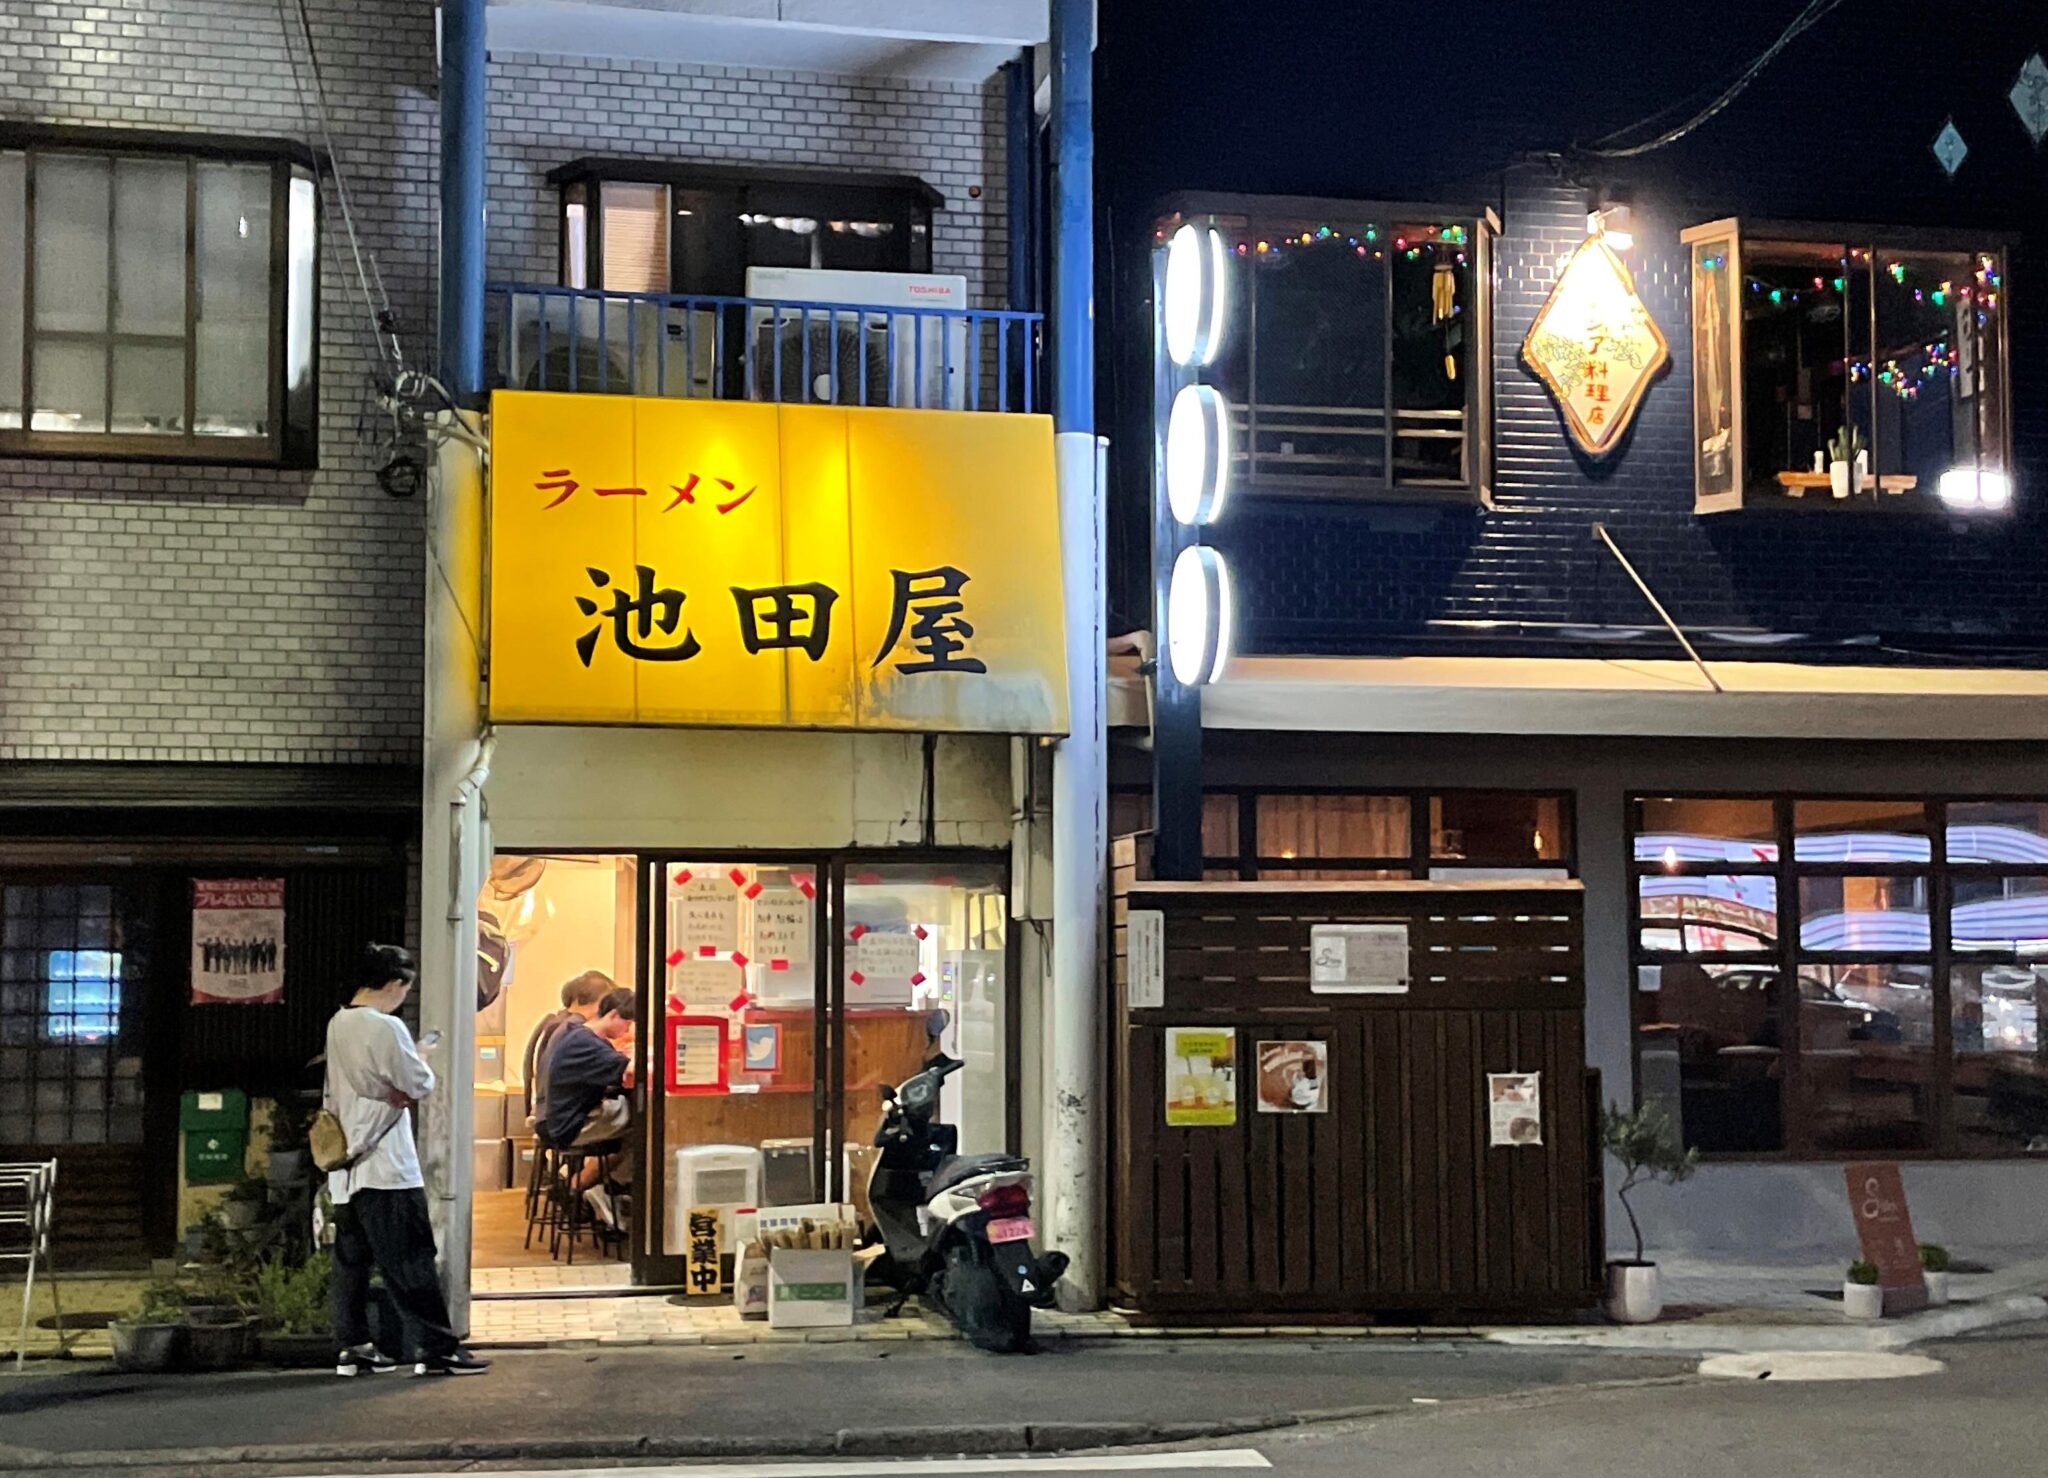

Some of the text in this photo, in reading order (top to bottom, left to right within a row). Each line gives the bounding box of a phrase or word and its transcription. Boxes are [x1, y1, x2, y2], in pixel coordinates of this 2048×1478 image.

[908, 285, 951, 294] TOSHIBA
[533, 468, 757, 515] ラーメン
[574, 564, 988, 675] 池田屋
[689, 1212, 718, 1293] 営業中
